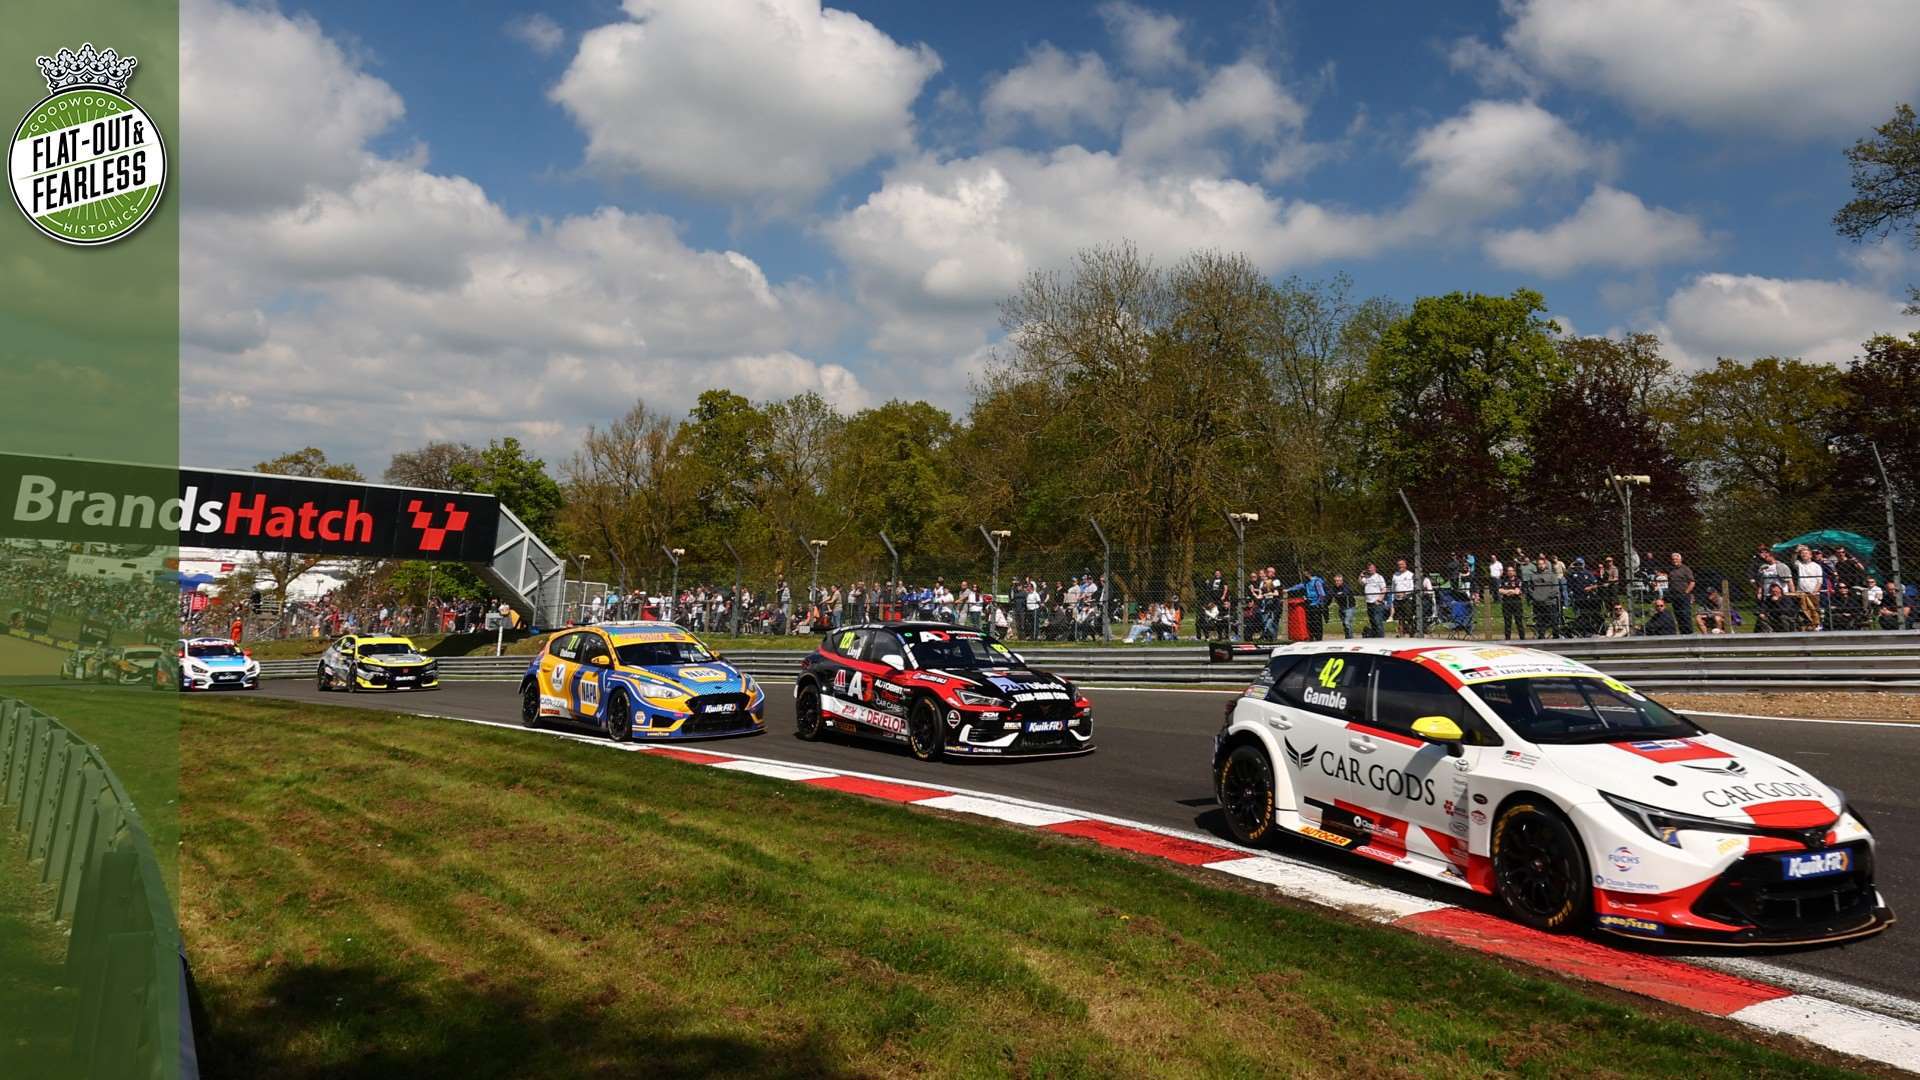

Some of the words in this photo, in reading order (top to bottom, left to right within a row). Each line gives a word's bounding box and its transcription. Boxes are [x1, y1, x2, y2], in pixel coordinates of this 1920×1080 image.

[686, 669, 721, 679] NAPA
[1318, 657, 1345, 689] 42
[581, 681, 598, 705] NAPA
[1303, 686, 1347, 710] Gamble
[866, 709, 907, 733] DEVELOP
[1320, 750, 1366, 786] CAR
[1368, 764, 1436, 806] GODS
[1702, 785, 1763, 808] CAR
[1754, 782, 1822, 799] GODS
[1300, 825, 1349, 846] AUTOCAR
[1608, 854, 1640, 865] FUCHS
[1606, 878, 1625, 886] Close
[1625, 880, 1660, 890] Brothers
